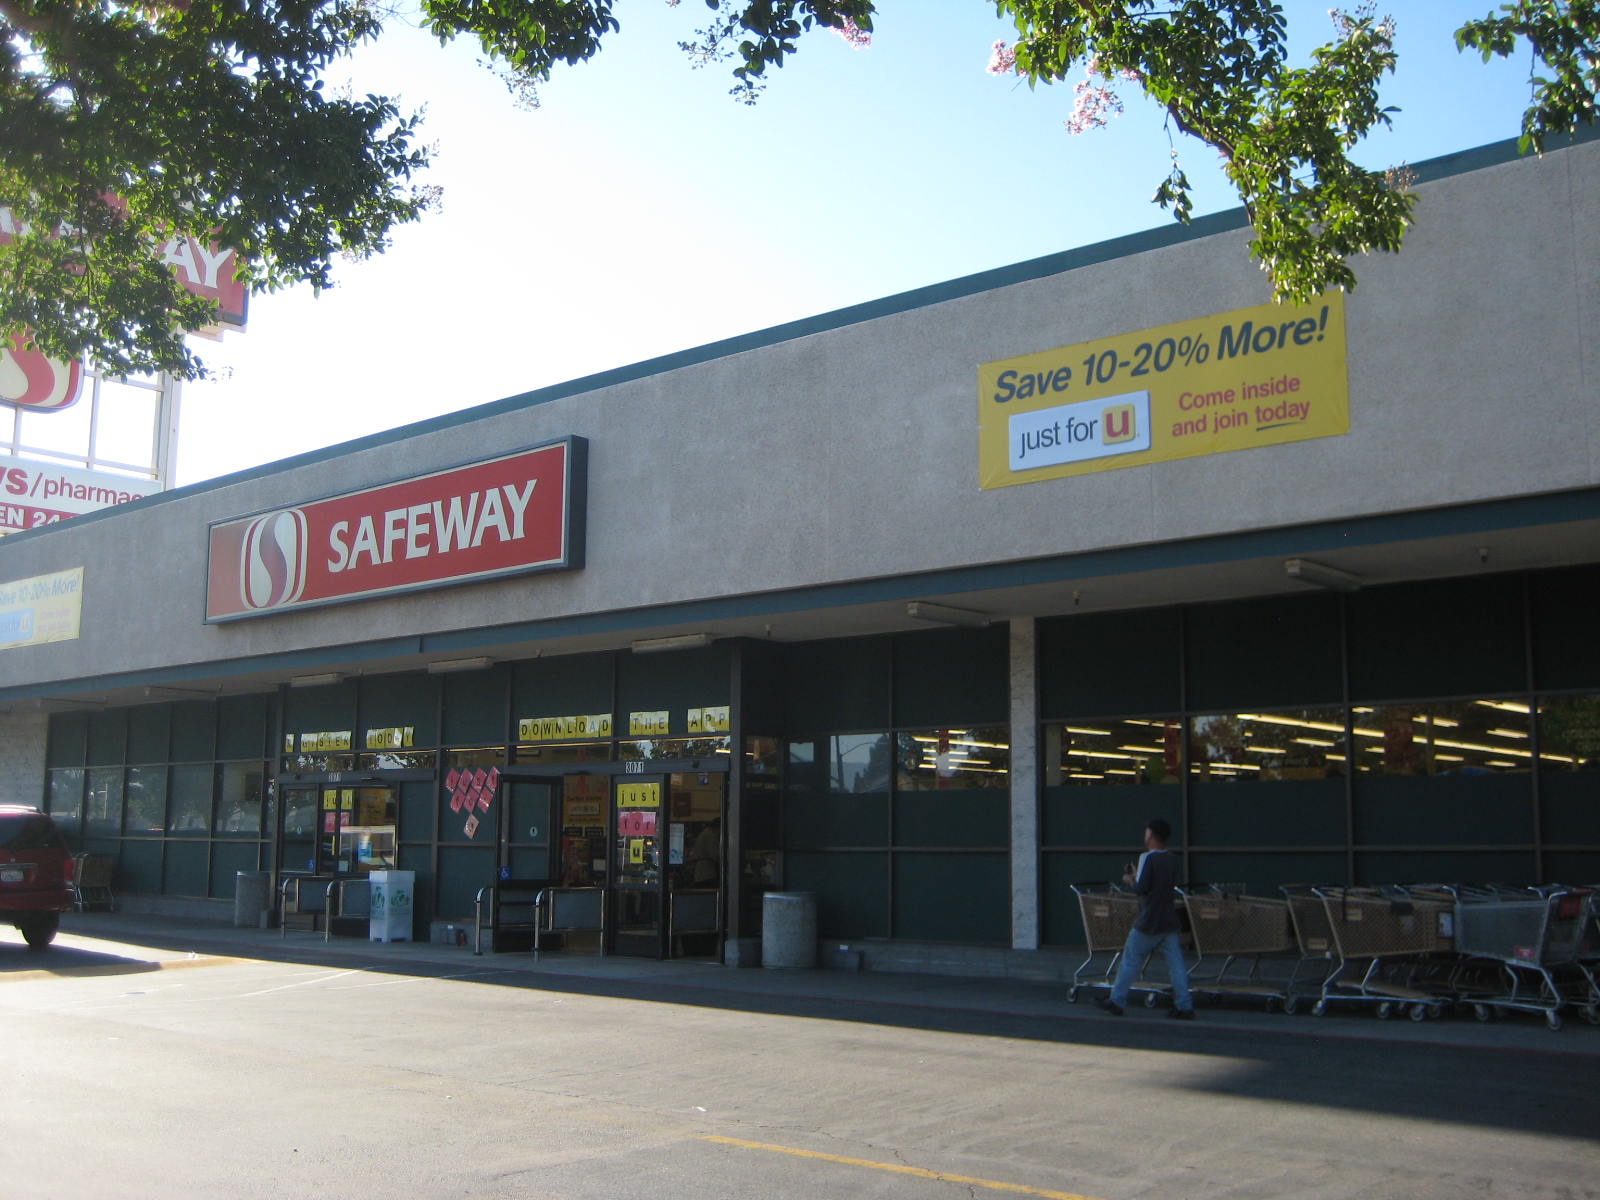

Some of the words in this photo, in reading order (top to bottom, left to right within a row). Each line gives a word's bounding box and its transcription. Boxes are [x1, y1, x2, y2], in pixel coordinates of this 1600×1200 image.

[993, 366, 1072, 403] Save
[1082, 333, 1210, 386] 10-20%
[1217, 306, 1329, 360] More!
[1178, 386, 1236, 411] Come
[1242, 374, 1301, 399] inside
[1171, 413, 1208, 437] and
[1212, 409, 1249, 434] join
[1255, 399, 1311, 424] today
[1019, 422, 1061, 458] just
[1065, 416, 1098, 444] for
[327, 479, 538, 573] SAFEWAY
[521, 718, 609, 737] DOWNLOAD
[633, 715, 666, 731] THE
[690, 710, 726, 728] APP
[286, 736, 350, 750] RGISTER
[625, 761, 645, 774] 3071
[621, 789, 656, 805] just
[623, 816, 651, 831] for
